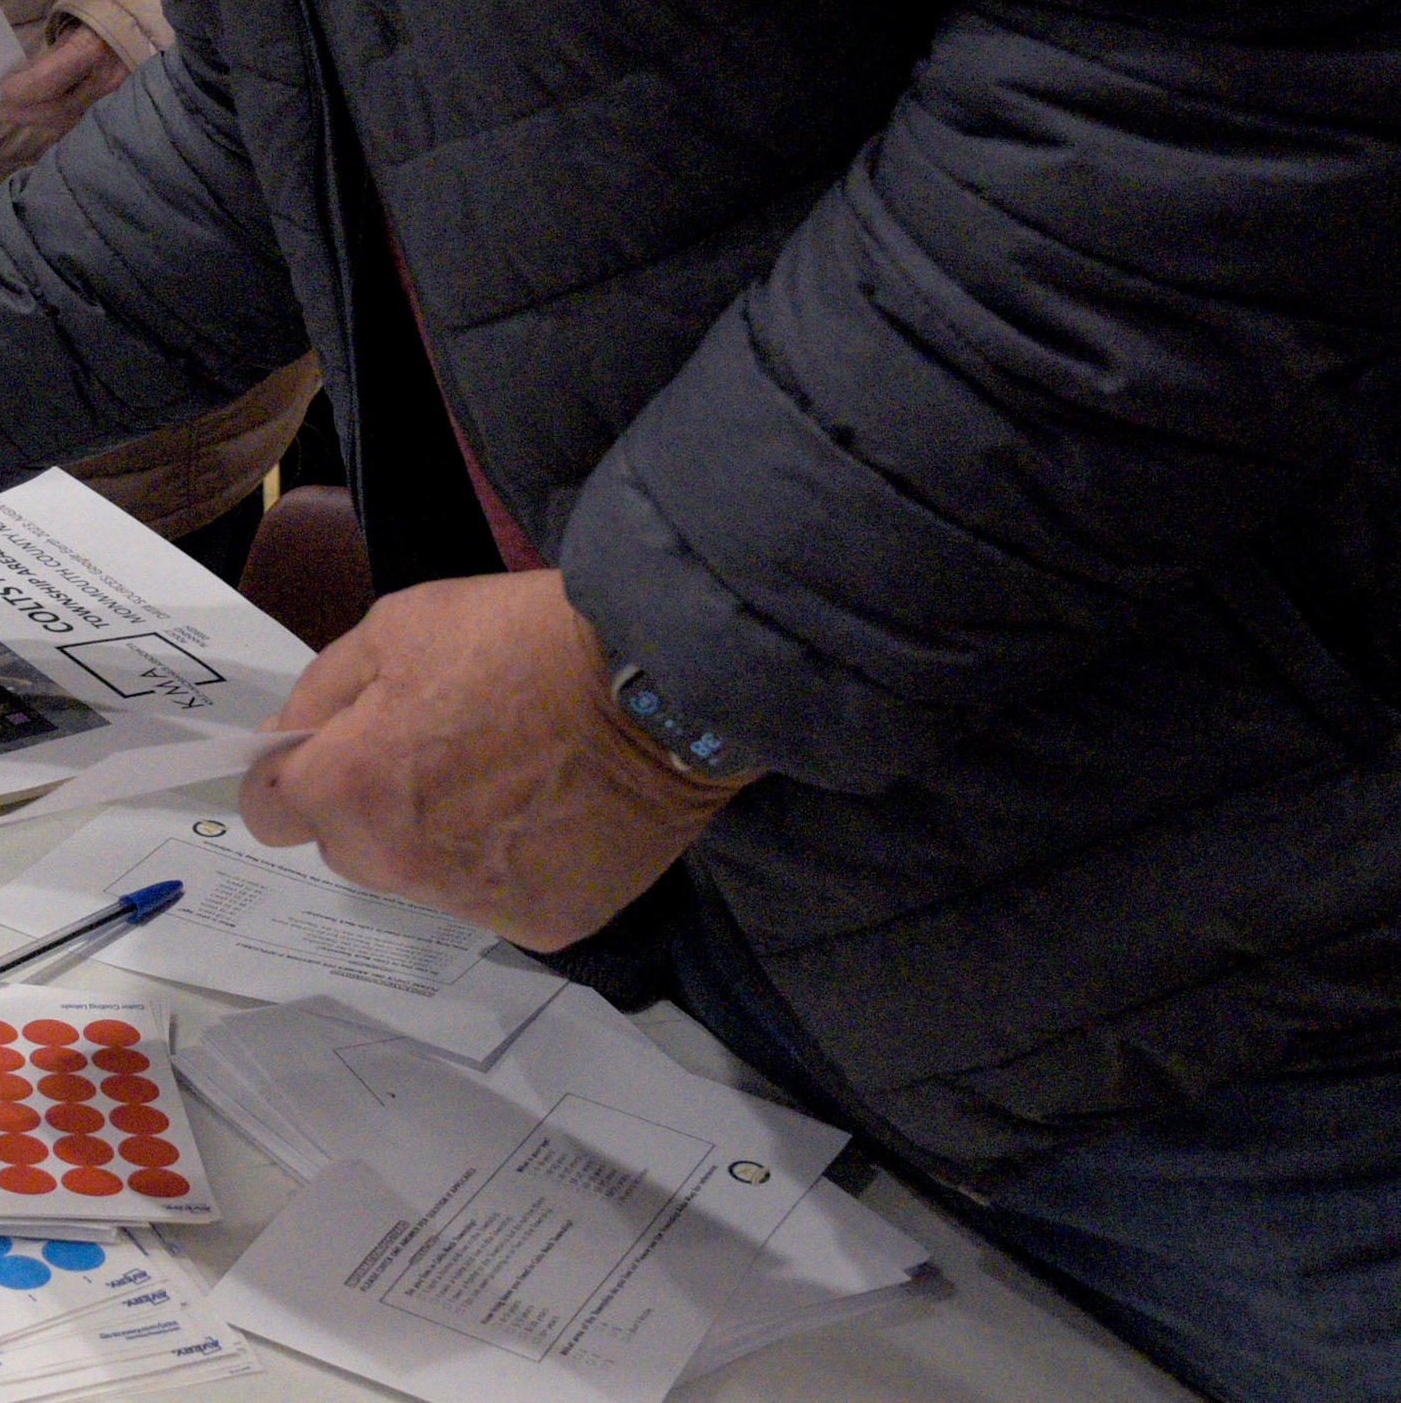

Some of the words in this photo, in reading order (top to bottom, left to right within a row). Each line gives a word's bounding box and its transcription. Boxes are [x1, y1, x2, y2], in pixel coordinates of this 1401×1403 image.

[1, 532, 65, 568] COUNTY
[25, 576, 113, 628] TOWNSHIP
[52, 568, 147, 624] MONMOUTH
